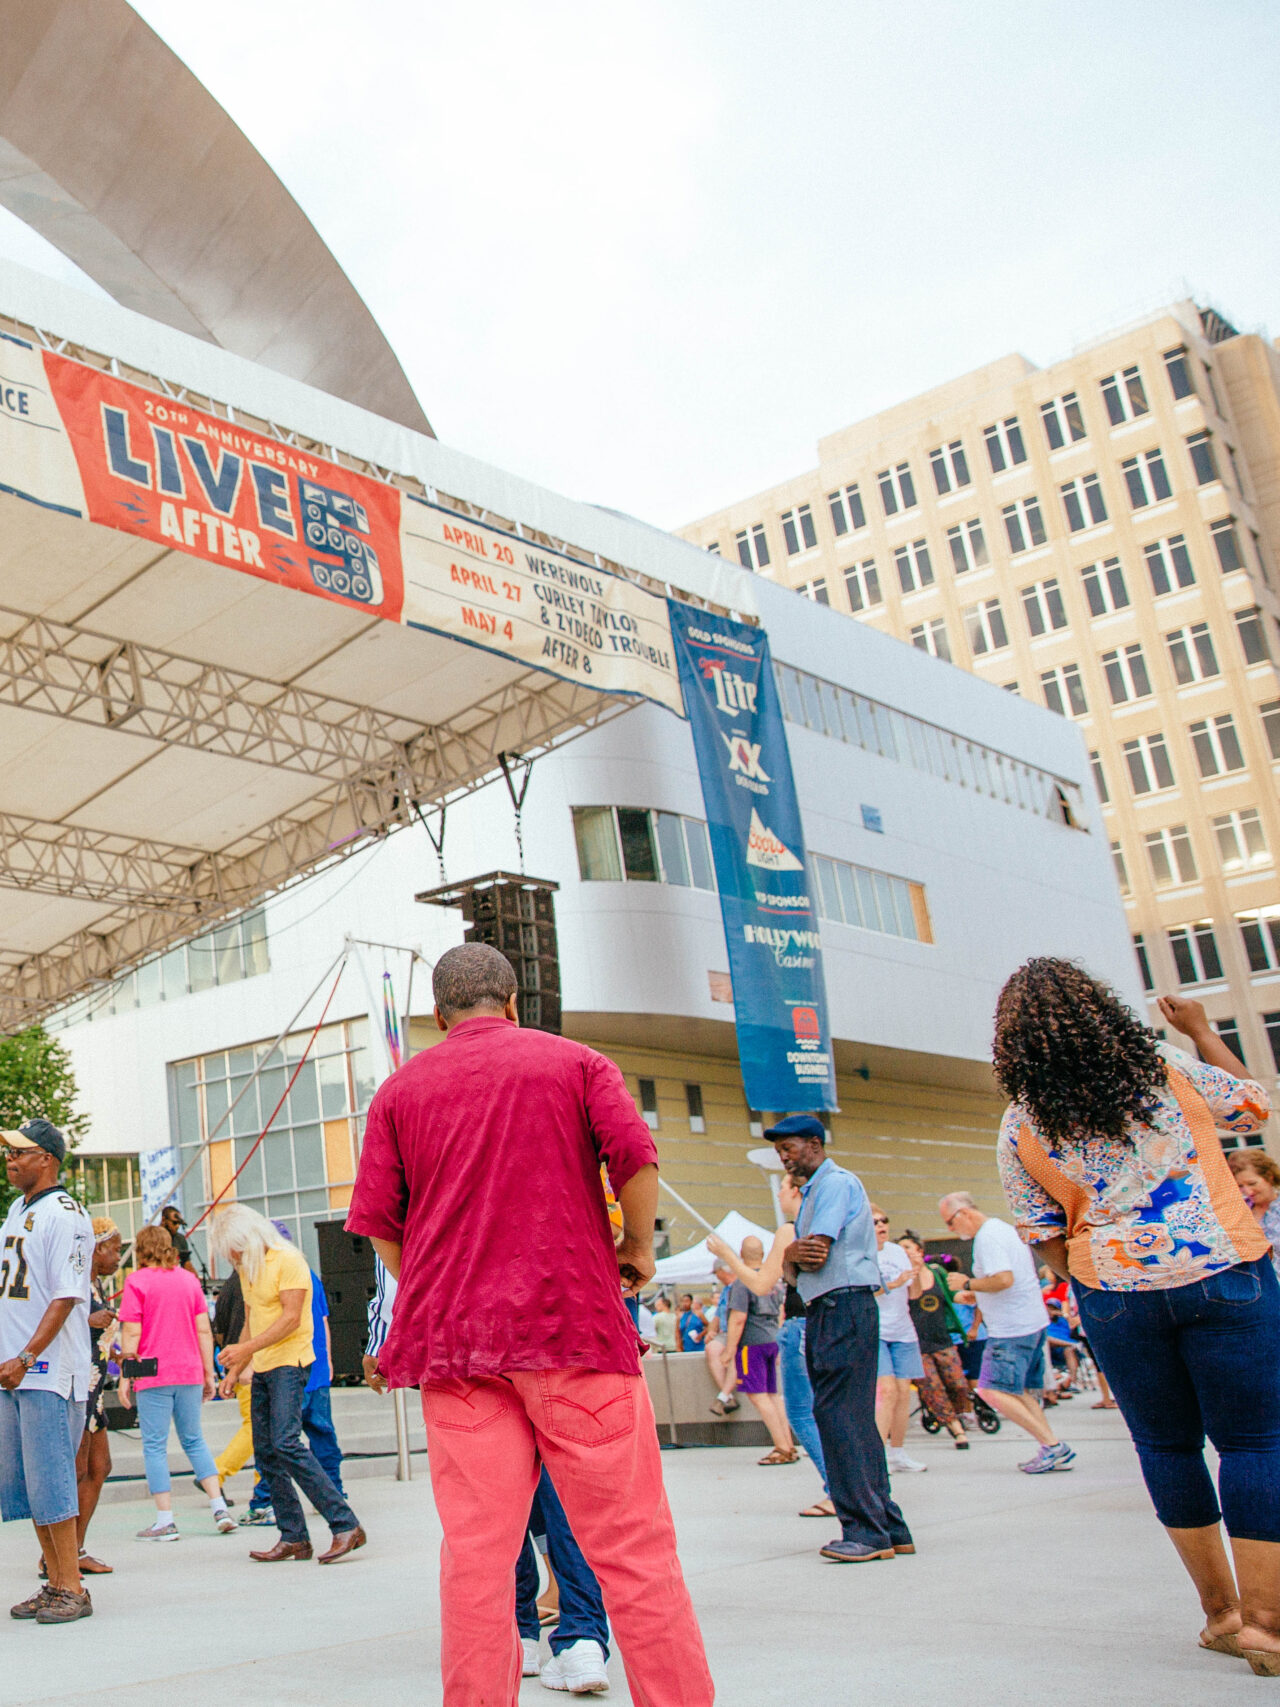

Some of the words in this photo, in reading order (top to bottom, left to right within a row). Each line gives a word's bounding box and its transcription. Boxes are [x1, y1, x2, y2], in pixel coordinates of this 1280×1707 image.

[144, 400, 189, 425] 20TH
[195, 420, 319, 479] ANNIVERSARY
[100, 400, 298, 542] LIVE
[160, 501, 265, 570] AFTER
[443, 523, 488, 557] APRIL
[493, 542, 515, 566] 20
[450, 564, 498, 596] APRIL
[502, 581, 521, 602] 27
[525, 553, 604, 598] WEREWOLF
[461, 606, 497, 635] MAY
[503, 620, 514, 641] 4
[533, 583, 585, 617] CURLEY
[590, 603, 639, 635] TAYLOR
[540, 605, 551, 626] &
[556, 613, 602, 649] ZYDECO
[609, 635, 671, 670] TROUBLE
[542, 636, 579, 671] AFTER
[582, 655, 593, 675] 8
[711, 666, 758, 718] Lite
